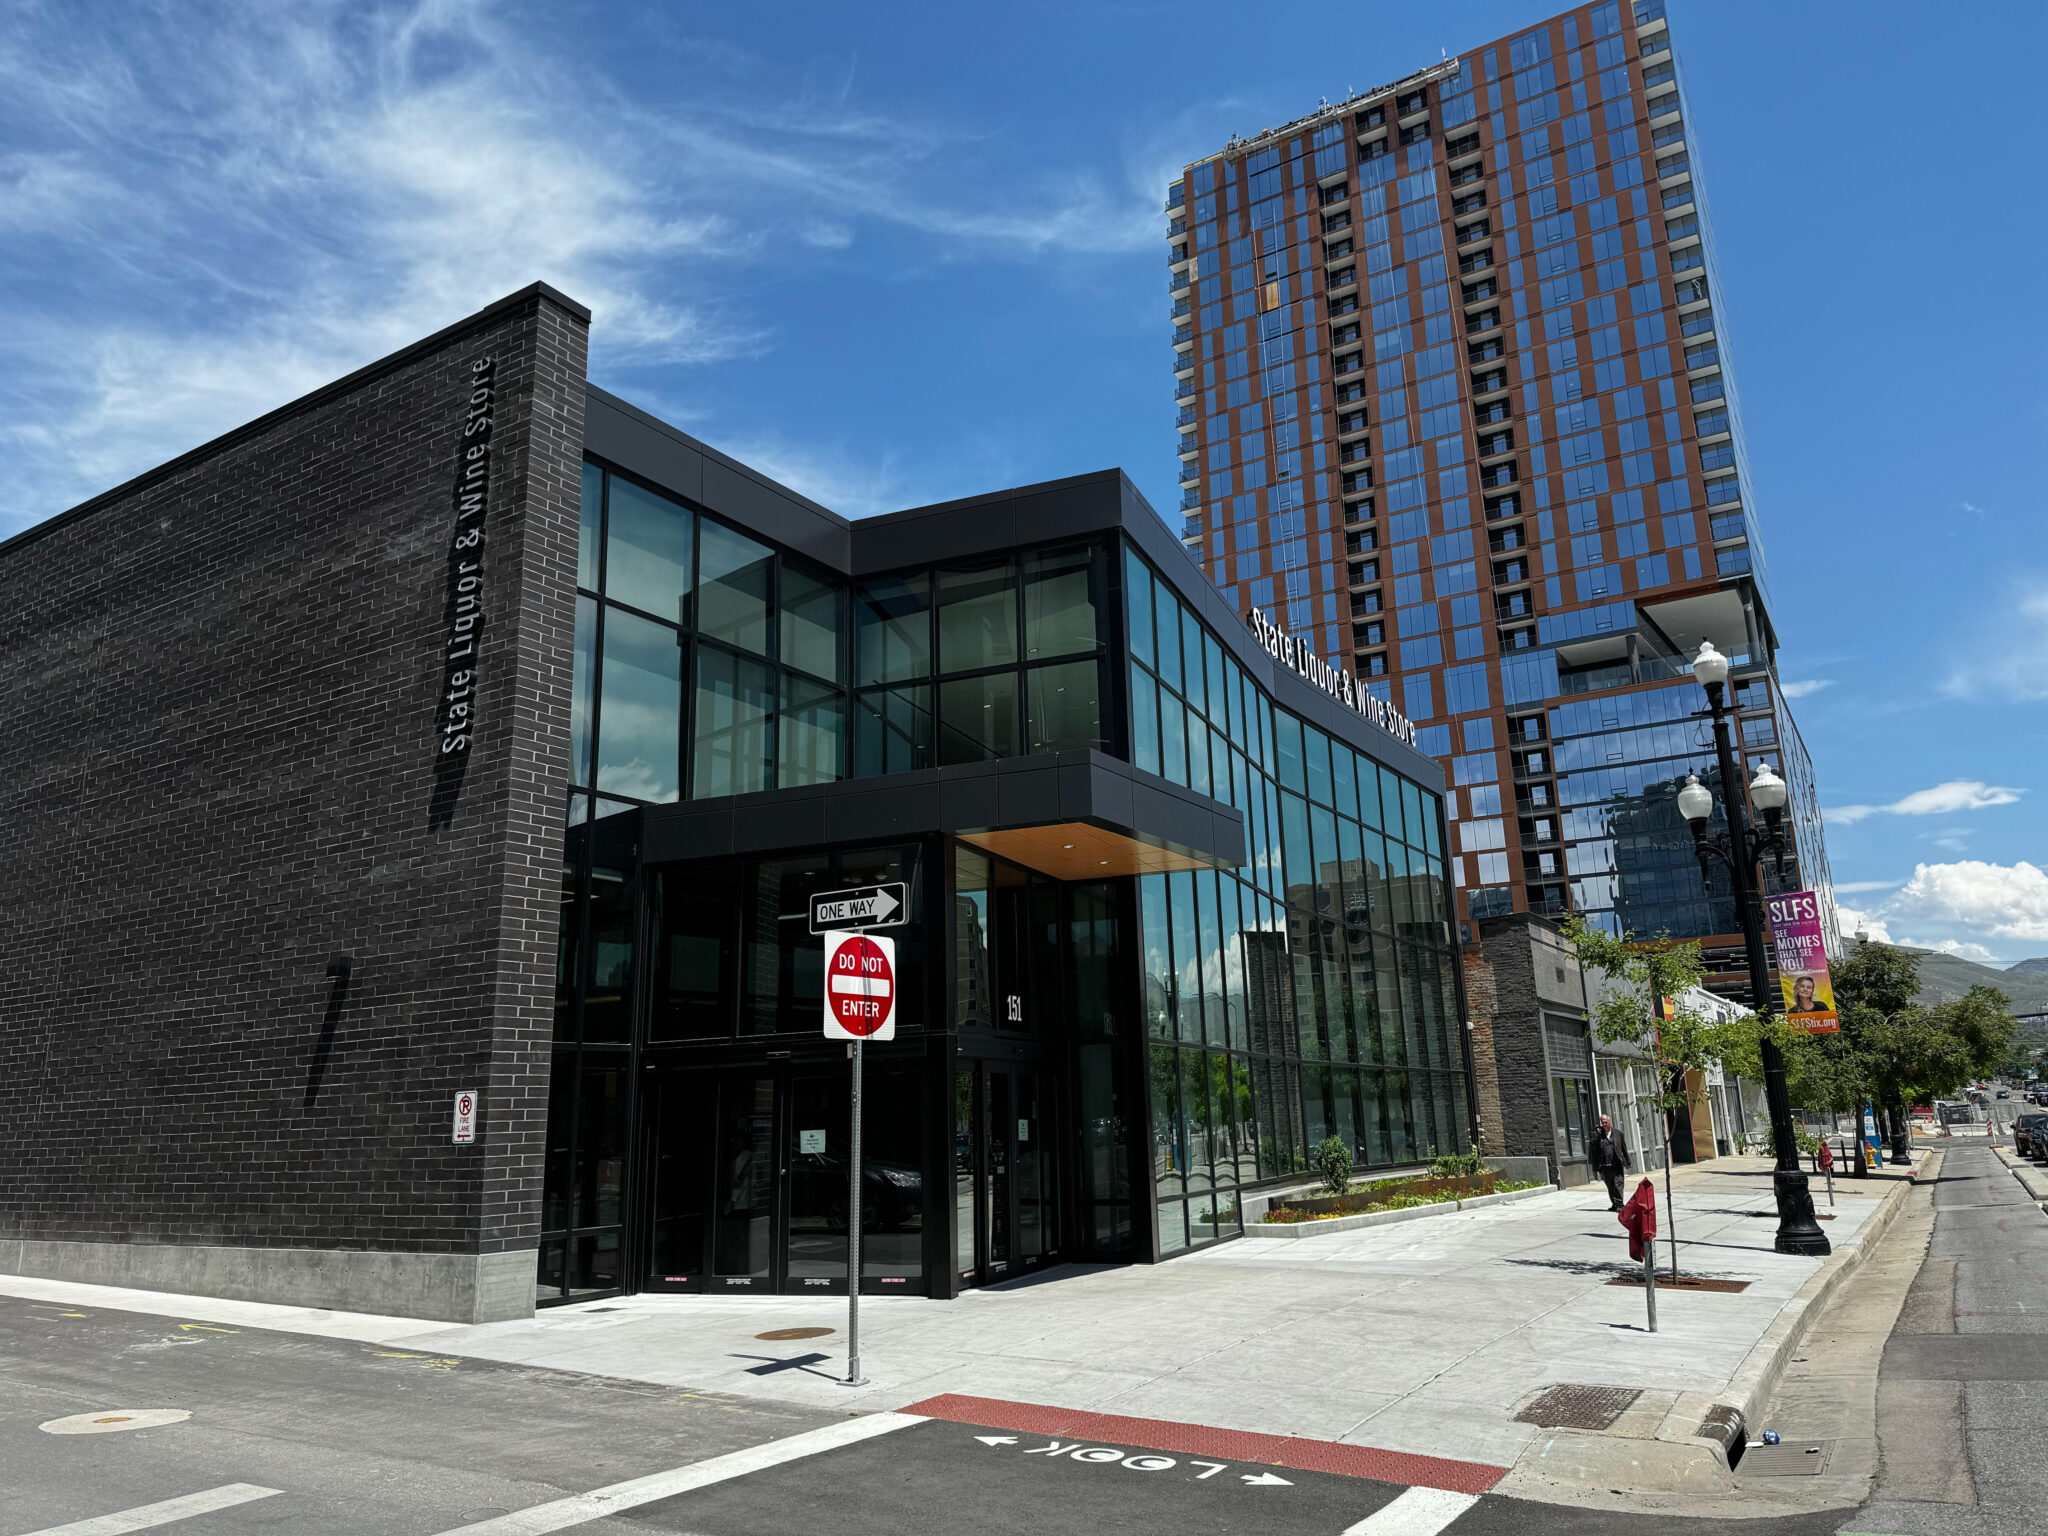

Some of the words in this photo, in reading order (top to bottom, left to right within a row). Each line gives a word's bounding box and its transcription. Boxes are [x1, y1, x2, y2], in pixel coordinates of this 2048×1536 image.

[465, 355, 492, 438] Store
[459, 444, 486, 519] Wine
[456, 526, 480, 547] &
[449, 562, 479, 659] Liquor
[1252, 607, 1295, 669] State
[1296, 637, 1341, 699] Liquor
[1340, 668, 1352, 707] &
[1354, 677, 1386, 728] Wine
[1385, 701, 1417, 748] Store
[442, 669, 472, 753] State
[820, 903, 845, 920] ONE
[850, 899, 875, 917] WAY
[1769, 898, 1815, 923] SLFS
[1774, 929, 1788, 939] SEE
[1776, 934, 1821, 950] MOVIES
[839, 953, 855, 970] DO
[861, 957, 883, 973] NOT
[1778, 949, 1798, 959] THAT
[1800, 948, 1814, 957] SEE
[1780, 958, 1805, 971] YOU
[842, 1000, 880, 1018] ENTER
[1007, 995, 1022, 1021] 151
[1023, 1441, 1228, 1480] LOOK
